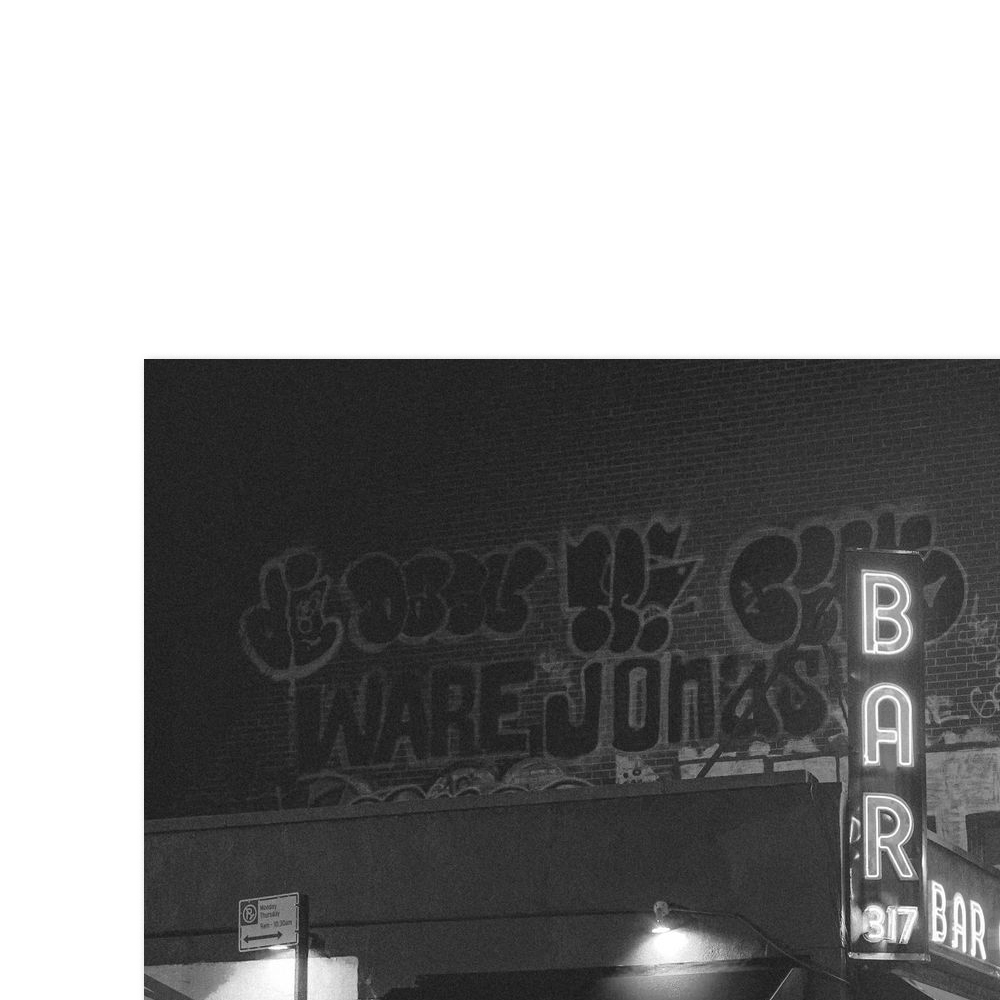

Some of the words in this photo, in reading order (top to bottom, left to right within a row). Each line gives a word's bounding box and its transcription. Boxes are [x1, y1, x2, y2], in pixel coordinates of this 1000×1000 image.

[861, 568, 919, 881] BAR
[862, 905, 919, 945] 317
[931, 879, 987, 961] BAR
